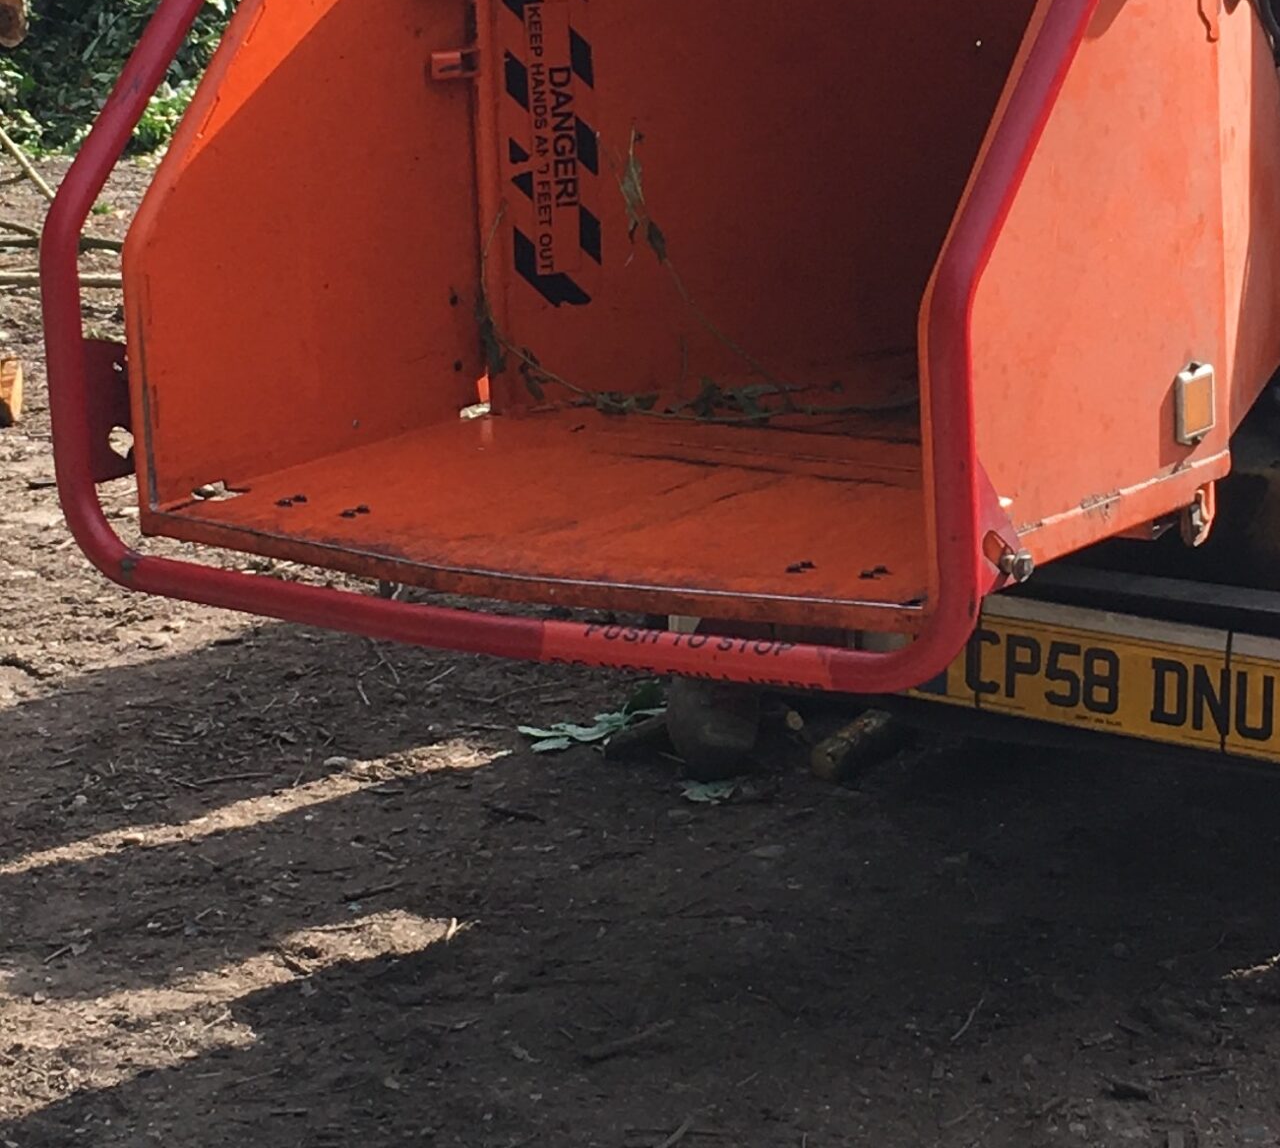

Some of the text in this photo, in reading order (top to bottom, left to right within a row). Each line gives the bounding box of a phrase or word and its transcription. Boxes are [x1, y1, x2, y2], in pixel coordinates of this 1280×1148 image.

[528, 5, 543, 57] KEEP
[530, 63, 548, 129] HANDS
[549, 66, 578, 208] DANGER!
[537, 180, 552, 228] FEET
[539, 233, 554, 272] OUT
[965, 628, 1275, 741] CP58 DNU
